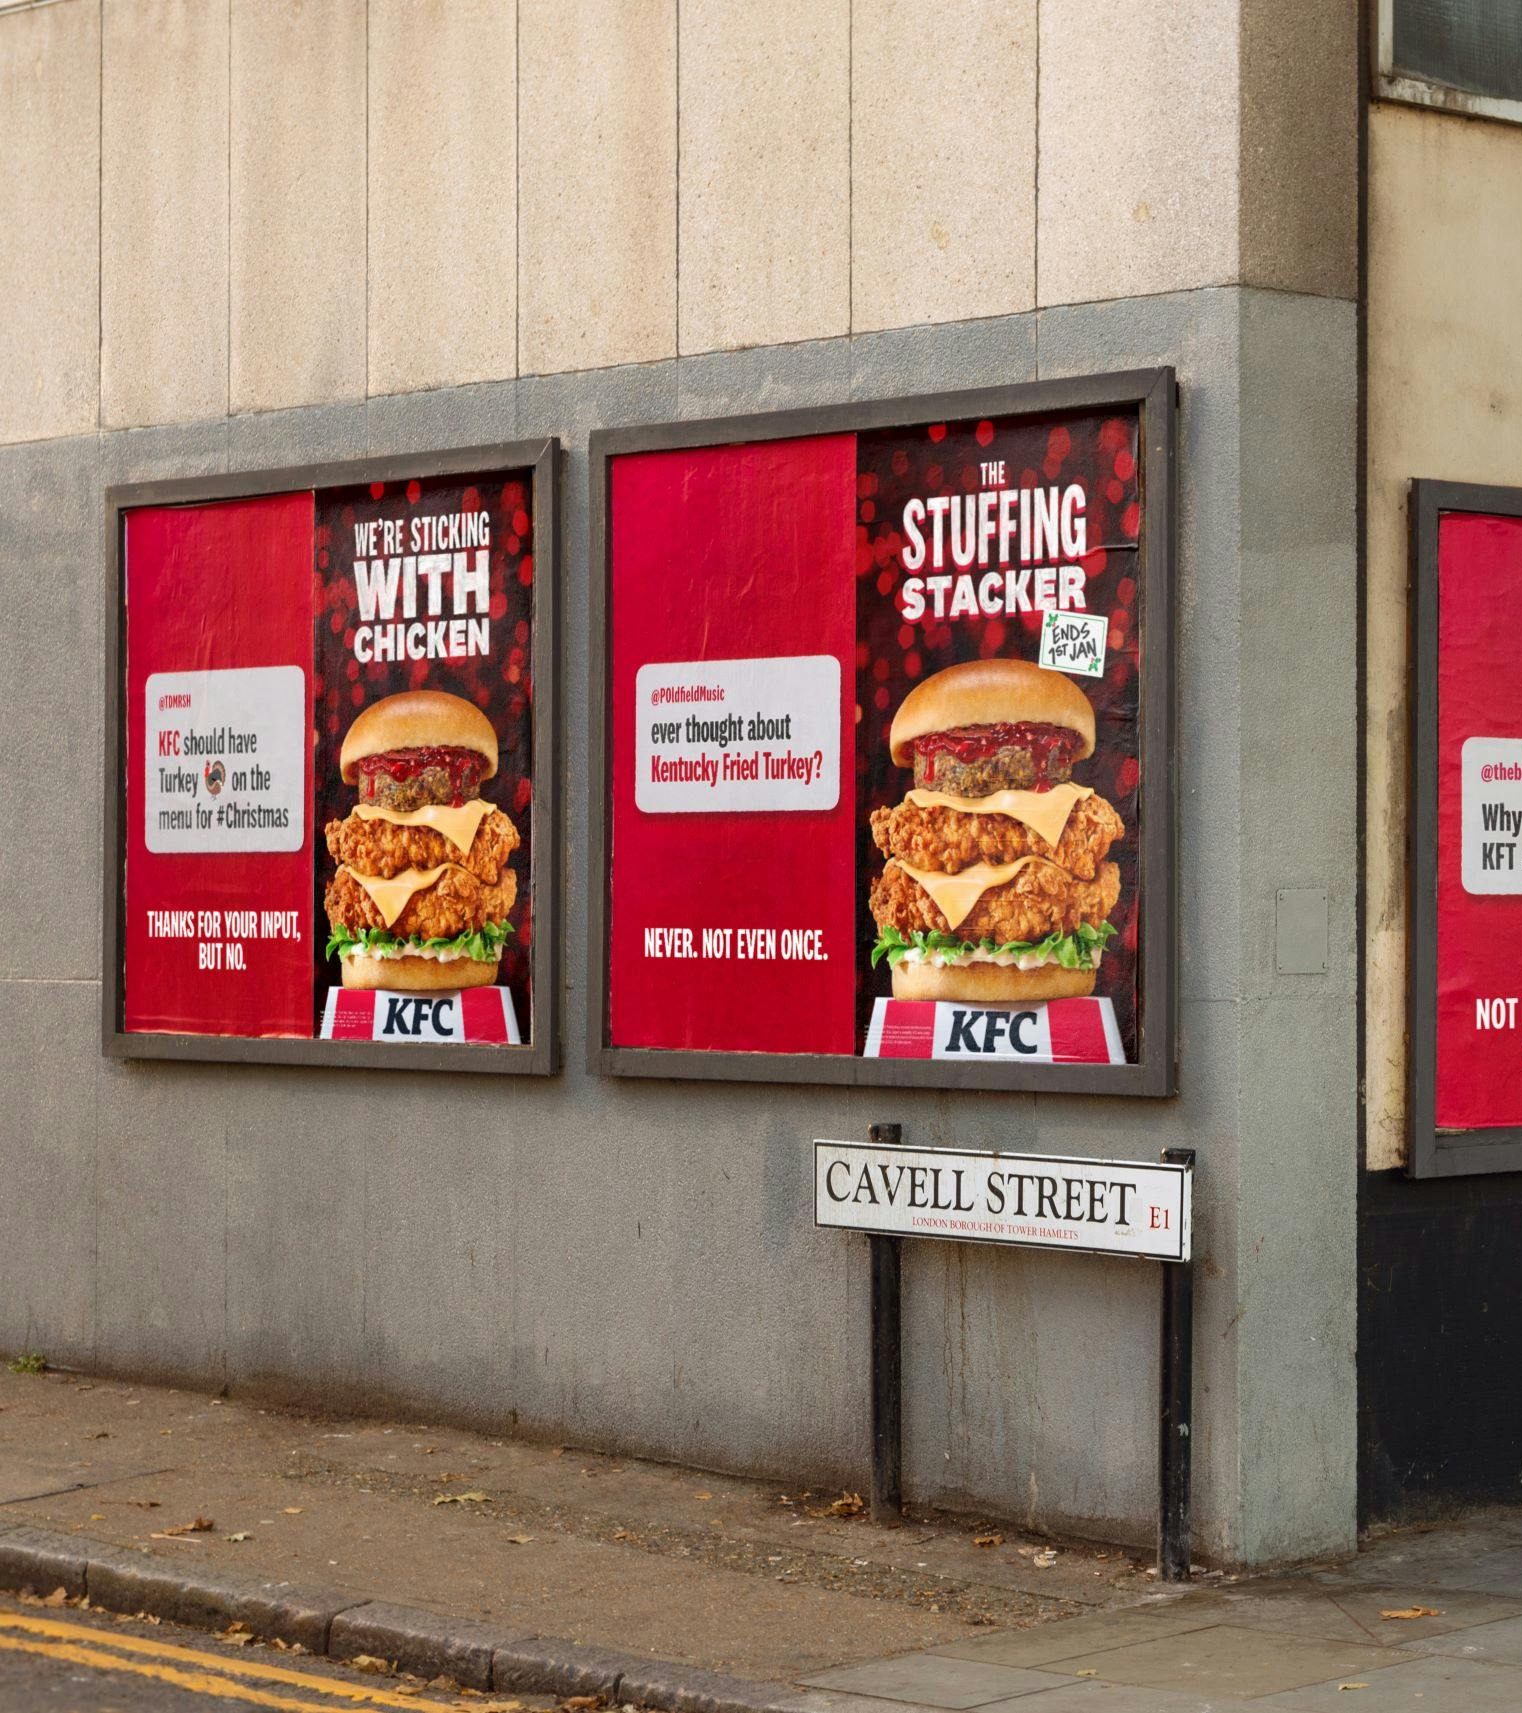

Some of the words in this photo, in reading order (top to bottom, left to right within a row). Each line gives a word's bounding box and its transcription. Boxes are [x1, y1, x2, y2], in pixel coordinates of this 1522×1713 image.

[980, 461, 1005, 485] THE
[354, 518, 404, 557] WE'RE
[410, 511, 489, 552] STICKING
[902, 483, 1087, 570] STUFFING
[353, 550, 489, 622] WITH
[901, 566, 1087, 620] STACKER
[354, 618, 489, 663] CHICKEN
[1053, 622, 1090, 644] ENDS
[1048, 643, 1068, 664] 1ST
[1070, 638, 1097, 661] JAN
[159, 694, 191, 711] @TDMRSH
[159, 730, 180, 756] KFC
[184, 727, 225, 755] should
[229, 727, 257, 754] have
[652, 721, 682, 744] ever
[686, 713, 743, 748] thought
[748, 712, 791, 740] about
[159, 766, 198, 798] Turkey
[232, 771, 247, 791] on
[251, 764, 271, 791] the
[652, 752, 718, 787] Kentucky
[722, 751, 758, 781] Fried
[763, 750, 823, 785] Turkey?
[159, 809, 192, 830] menu
[196, 802, 213, 829] for
[217, 801, 288, 829] #Christmas
[1482, 803, 1522, 837] Why
[1482, 843, 1516, 870] KFT
[147, 911, 194, 938] THANKS
[198, 911, 221, 938] FOR
[224, 911, 257, 938] YOUR
[261, 911, 301, 942] INPUT,
[199, 943, 223, 970] BUT
[226, 943, 246, 970] NO.
[644, 928, 698, 958] NEVER.
[702, 928, 732, 958] NOT
[737, 929, 776, 960] EVEN
[781, 929, 828, 960] ONCE.
[383, 998, 453, 1036] KFC
[1476, 998, 1518, 1030] NOT
[945, 1011, 1038, 1054] KFC
[825, 1160, 974, 1212] CAVELL
[986, 1171, 1137, 1226] STREET
[912, 1216, 949, 1230] LONDON
[950, 1220, 993, 1233] BOROUGH
[993, 1224, 1006, 1234] OF
[1007, 1224, 1039, 1237] TOWER
[1039, 1227, 1079, 1240] HAMLETS
[1149, 1206, 1170, 1230] E1
